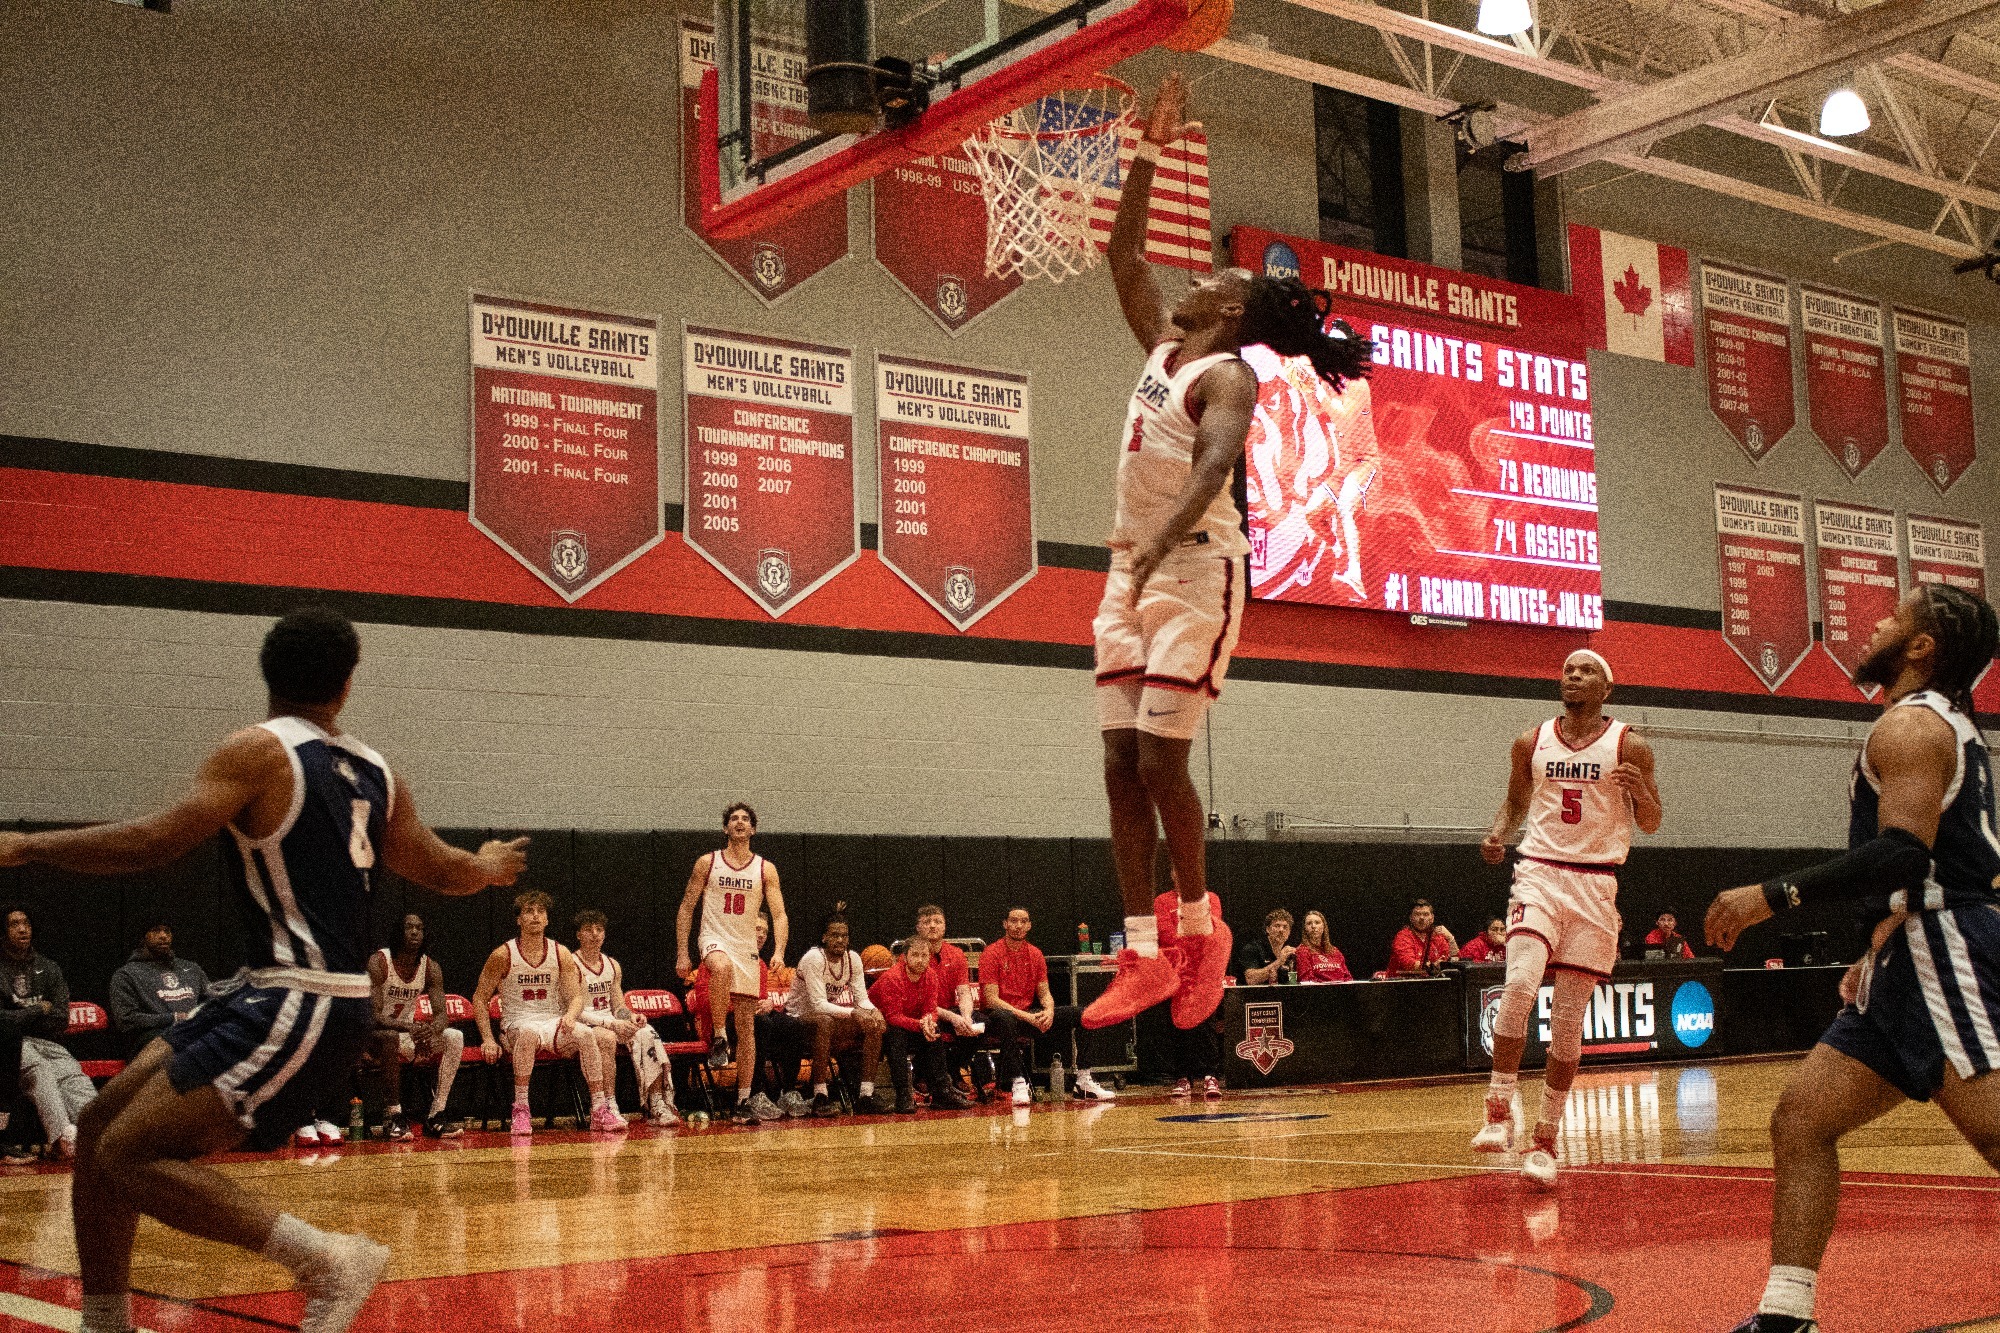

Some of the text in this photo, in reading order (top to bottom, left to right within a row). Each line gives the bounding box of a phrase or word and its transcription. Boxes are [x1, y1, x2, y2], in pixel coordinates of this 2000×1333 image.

[1743, 301, 1785, 320] BASKETBALL
[1839, 321, 1879, 342] BASKETBALL
[496, 346, 635, 379] MEN'S VOLLEYBALL
[1371, 324, 1588, 401] SAINTS STATS
[707, 374, 832, 405] MEN'S VOLLEYBALL
[491, 385, 644, 420] NATIONAL TOURNAMENT
[503, 412, 539, 429] 1999
[733, 409, 810, 434] CONFERENCE
[897, 401, 1011, 430] MEN'S VOLLEYBALL
[1509, 401, 1592, 441] 143 POINTS
[502, 433, 539, 450] 2000
[697, 426, 845, 459] TOURNAMENT CHAMPIONS
[889, 436, 1021, 467] CONFERENCE CHAMPIONS
[502, 458, 539, 474] 2001
[703, 450, 792, 473] 1999 2006
[893, 457, 925, 474] 1999
[702, 471, 792, 494] 2000 2007
[894, 478, 926, 495] 2000
[1522, 462, 1598, 504] REBOUNDS
[703, 493, 737, 510] 2001
[895, 499, 926, 515] 2001
[703, 515, 739, 532] 2005
[895, 520, 928, 536] 2006
[1722, 517, 1798, 538] WOMEN'S VOLLEYBALL
[1493, 518, 1598, 564] 74 ASSISTS
[1822, 532, 1893, 551] WOMEN'S VOLLEYBALL
[1724, 544, 1801, 566] CONFERENCE CHAMPIONS
[1841, 556, 1878, 571] CONFERENCE
[1913, 545, 1980, 564] WOMEN'S VOLLEYBALL
[1824, 568, 1896, 588] TOURNAMENT CHAMPIONS
[1918, 570, 1980, 589] NATIONAL TOURNAMENT
[1384, 572, 1603, 630] #1 RENARD FONTES-JULES
[1731, 624, 1750, 636] 2001
[1545, 761, 1601, 780] SAINTS
[1561, 788, 1583, 825] 5
[718, 876, 753, 890] SAINTS
[629, 994, 672, 1010] SAINTS
[1676, 1013, 1714, 1032] NCAA
